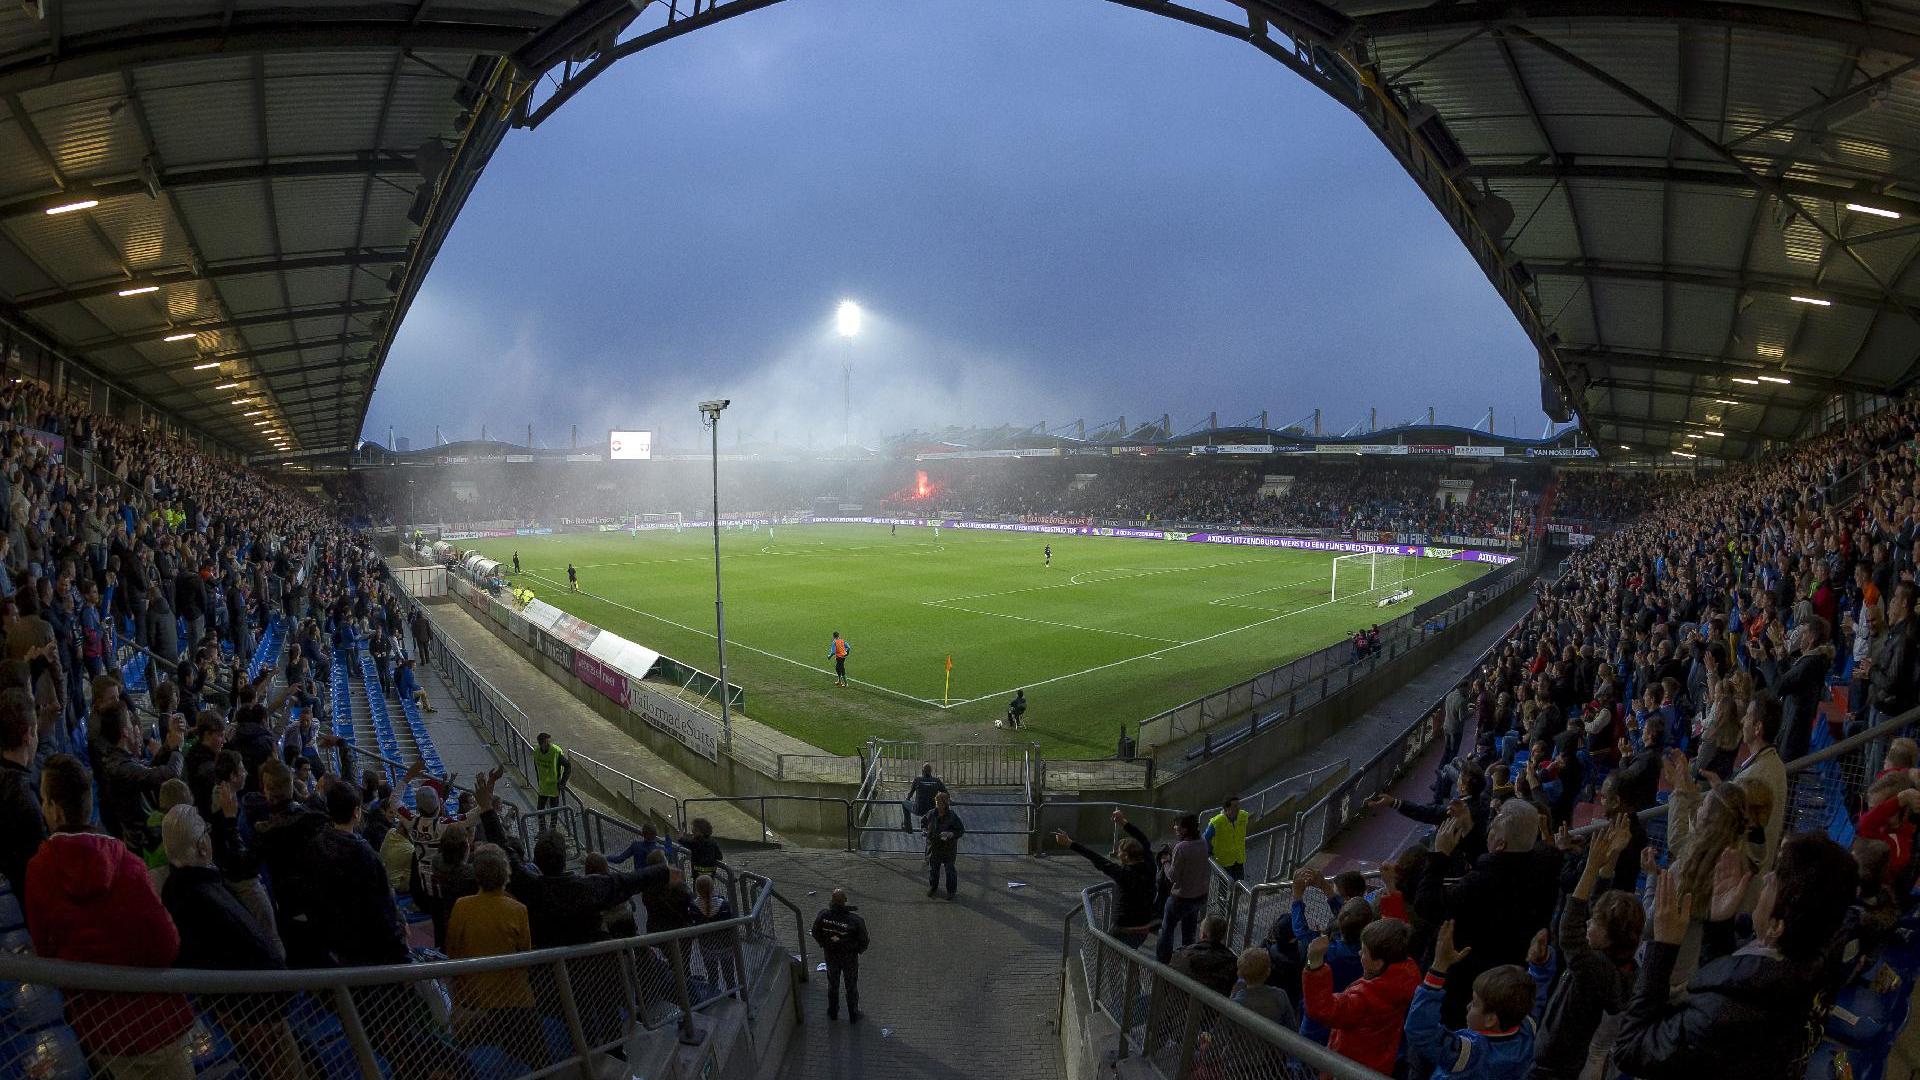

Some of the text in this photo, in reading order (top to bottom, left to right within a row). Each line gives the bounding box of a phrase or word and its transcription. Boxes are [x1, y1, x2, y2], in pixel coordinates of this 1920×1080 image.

[1207, 534, 1231, 543] AXIDUS
[1232, 536, 1279, 546] UITZENDBURO
[1280, 539, 1303, 548] WENST
[1311, 541, 1324, 549] EEN
[1385, 546, 1399, 554] TOE
[1356, 532, 1378, 542] KINGS
[1409, 533, 1427, 544] FIRE
